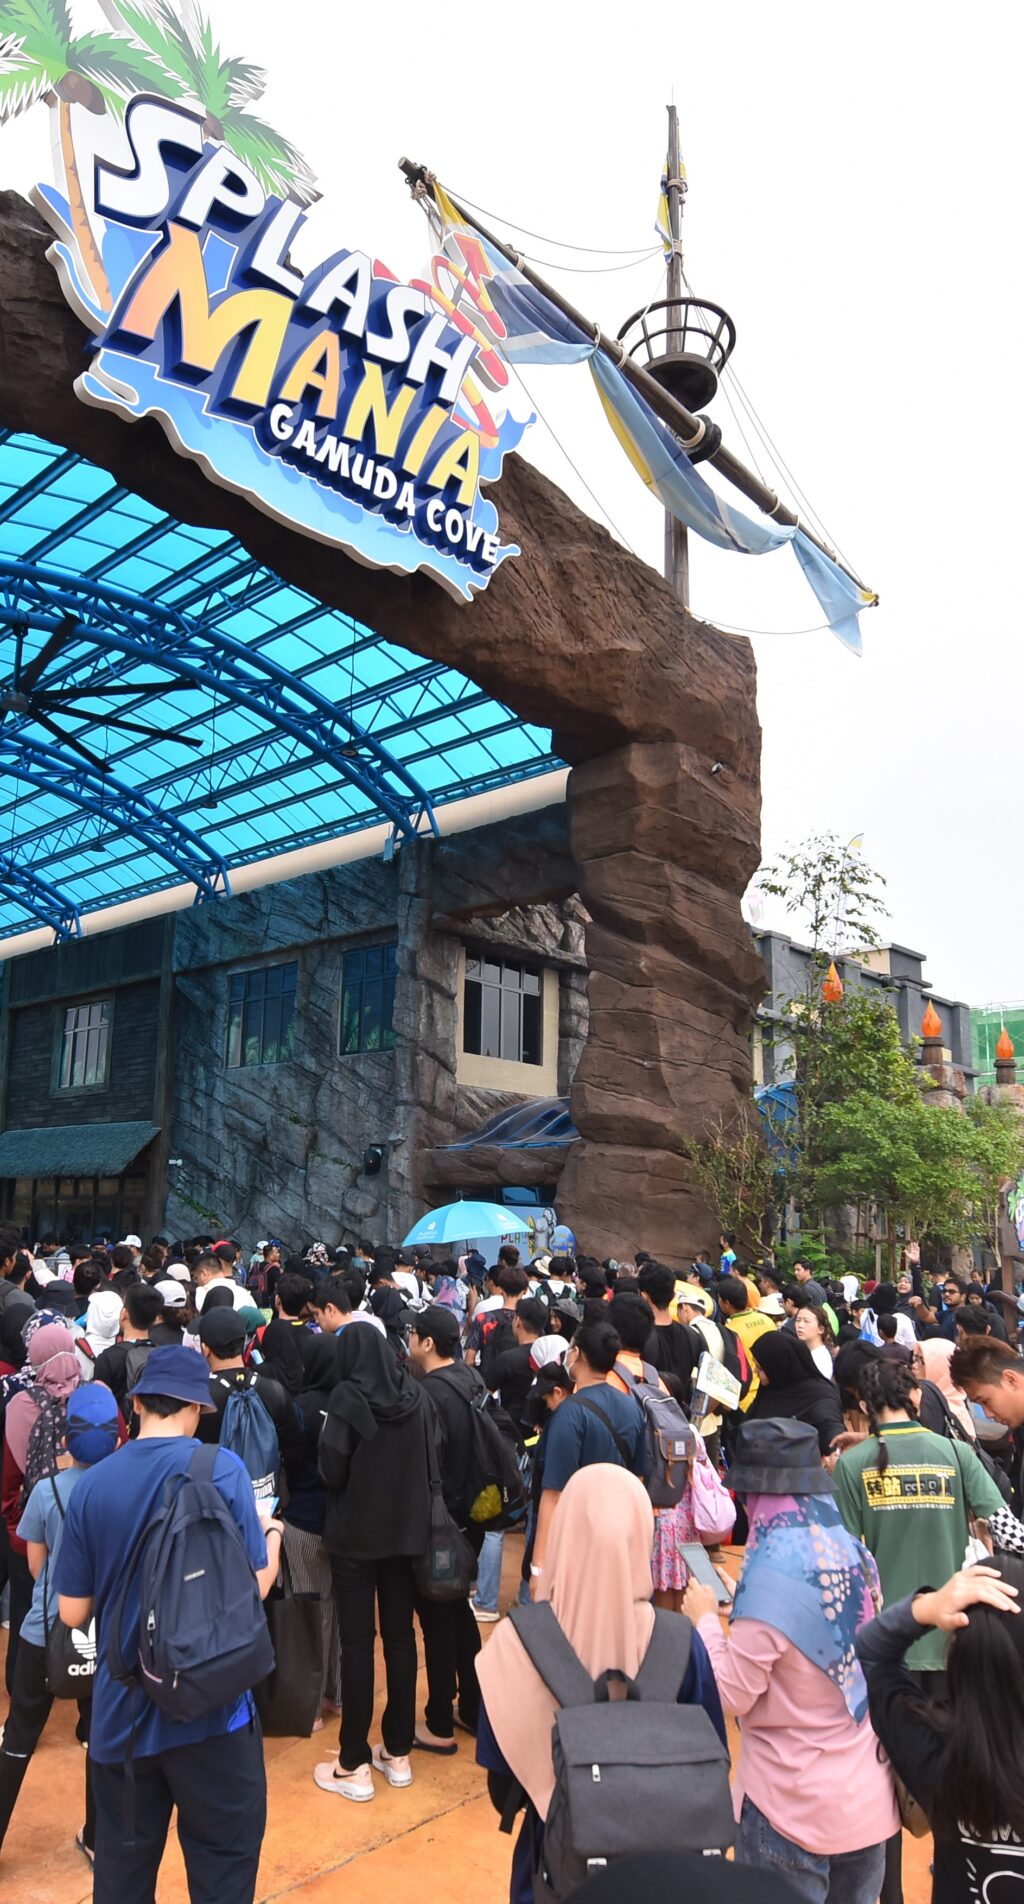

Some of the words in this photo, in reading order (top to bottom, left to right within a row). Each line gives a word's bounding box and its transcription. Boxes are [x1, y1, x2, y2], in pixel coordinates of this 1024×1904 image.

[97, 99, 478, 402] SPLASH
[121, 220, 480, 507] MANIA
[270, 403, 416, 517] GAMUDA
[426, 498, 501, 563] COVE
[67, 1660, 97, 1676] adi
